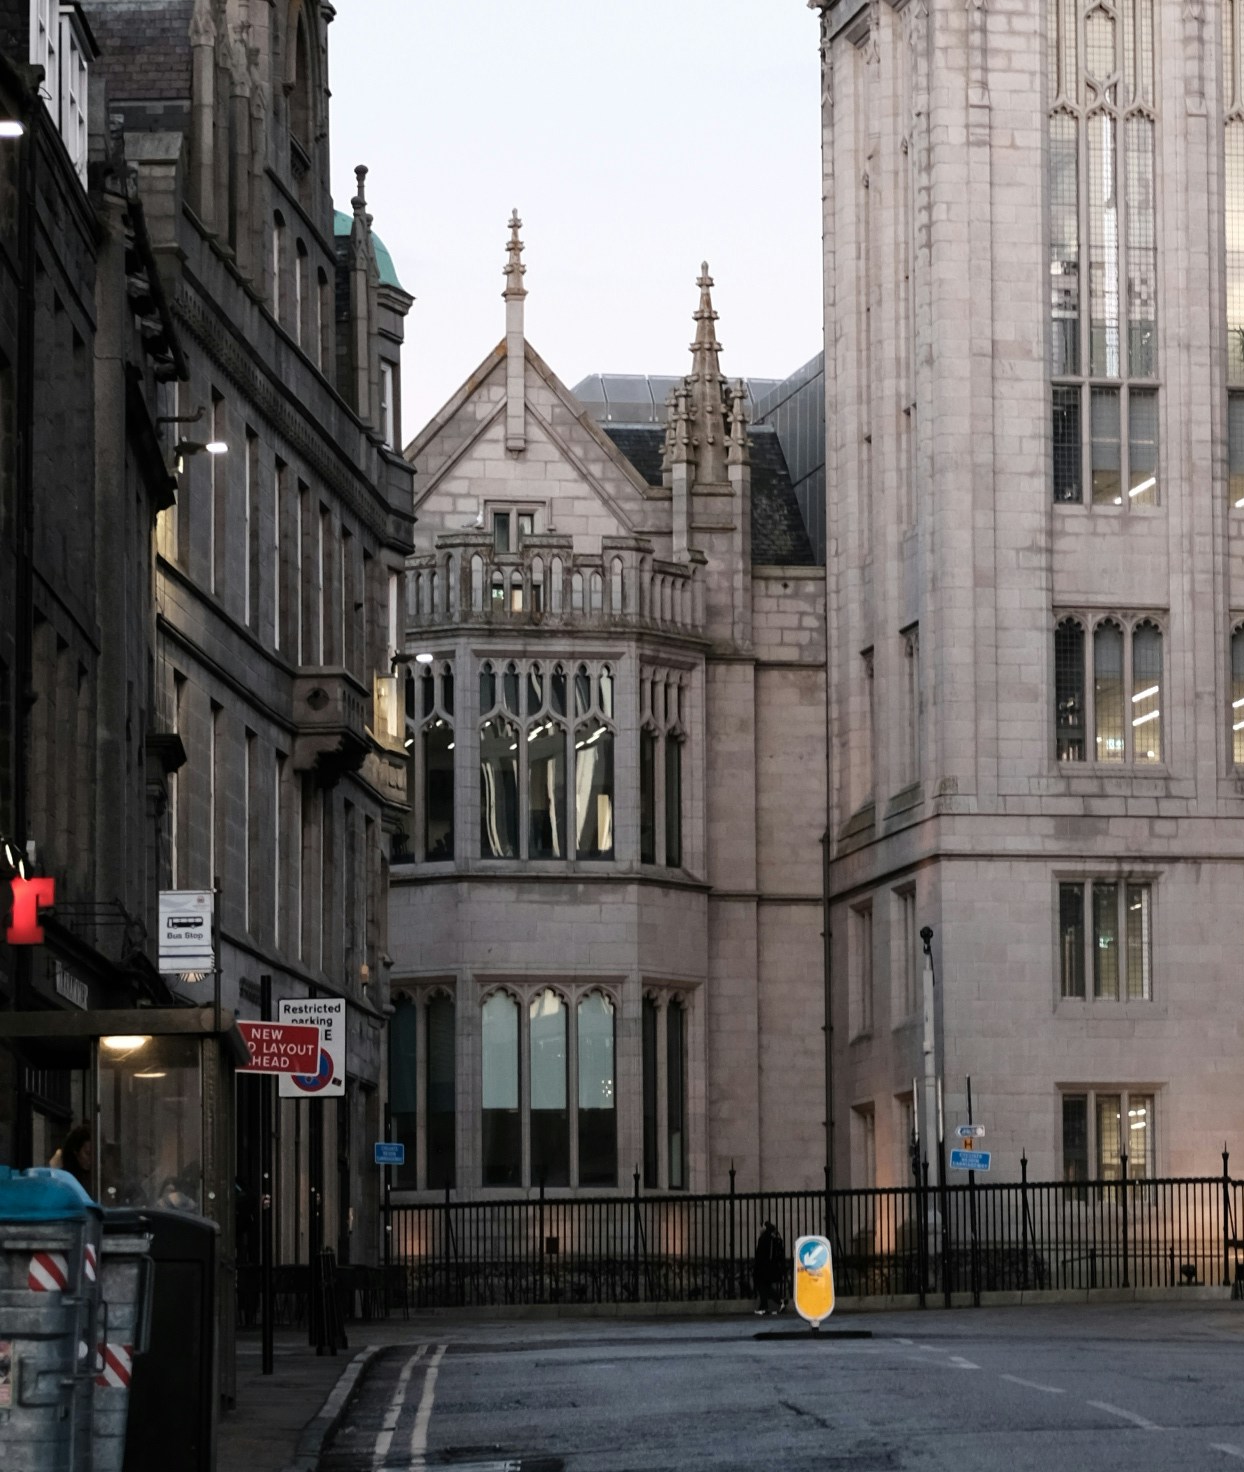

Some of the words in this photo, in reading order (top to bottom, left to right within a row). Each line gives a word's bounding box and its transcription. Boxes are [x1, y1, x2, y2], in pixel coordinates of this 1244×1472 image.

[185, 932, 203, 940] Stop
[284, 1003, 341, 1014] Restricted
[251, 1028, 283, 1040] NEW
[263, 1042, 314, 1055] LAYOUT
[248, 1056, 289, 1068] HEAD
